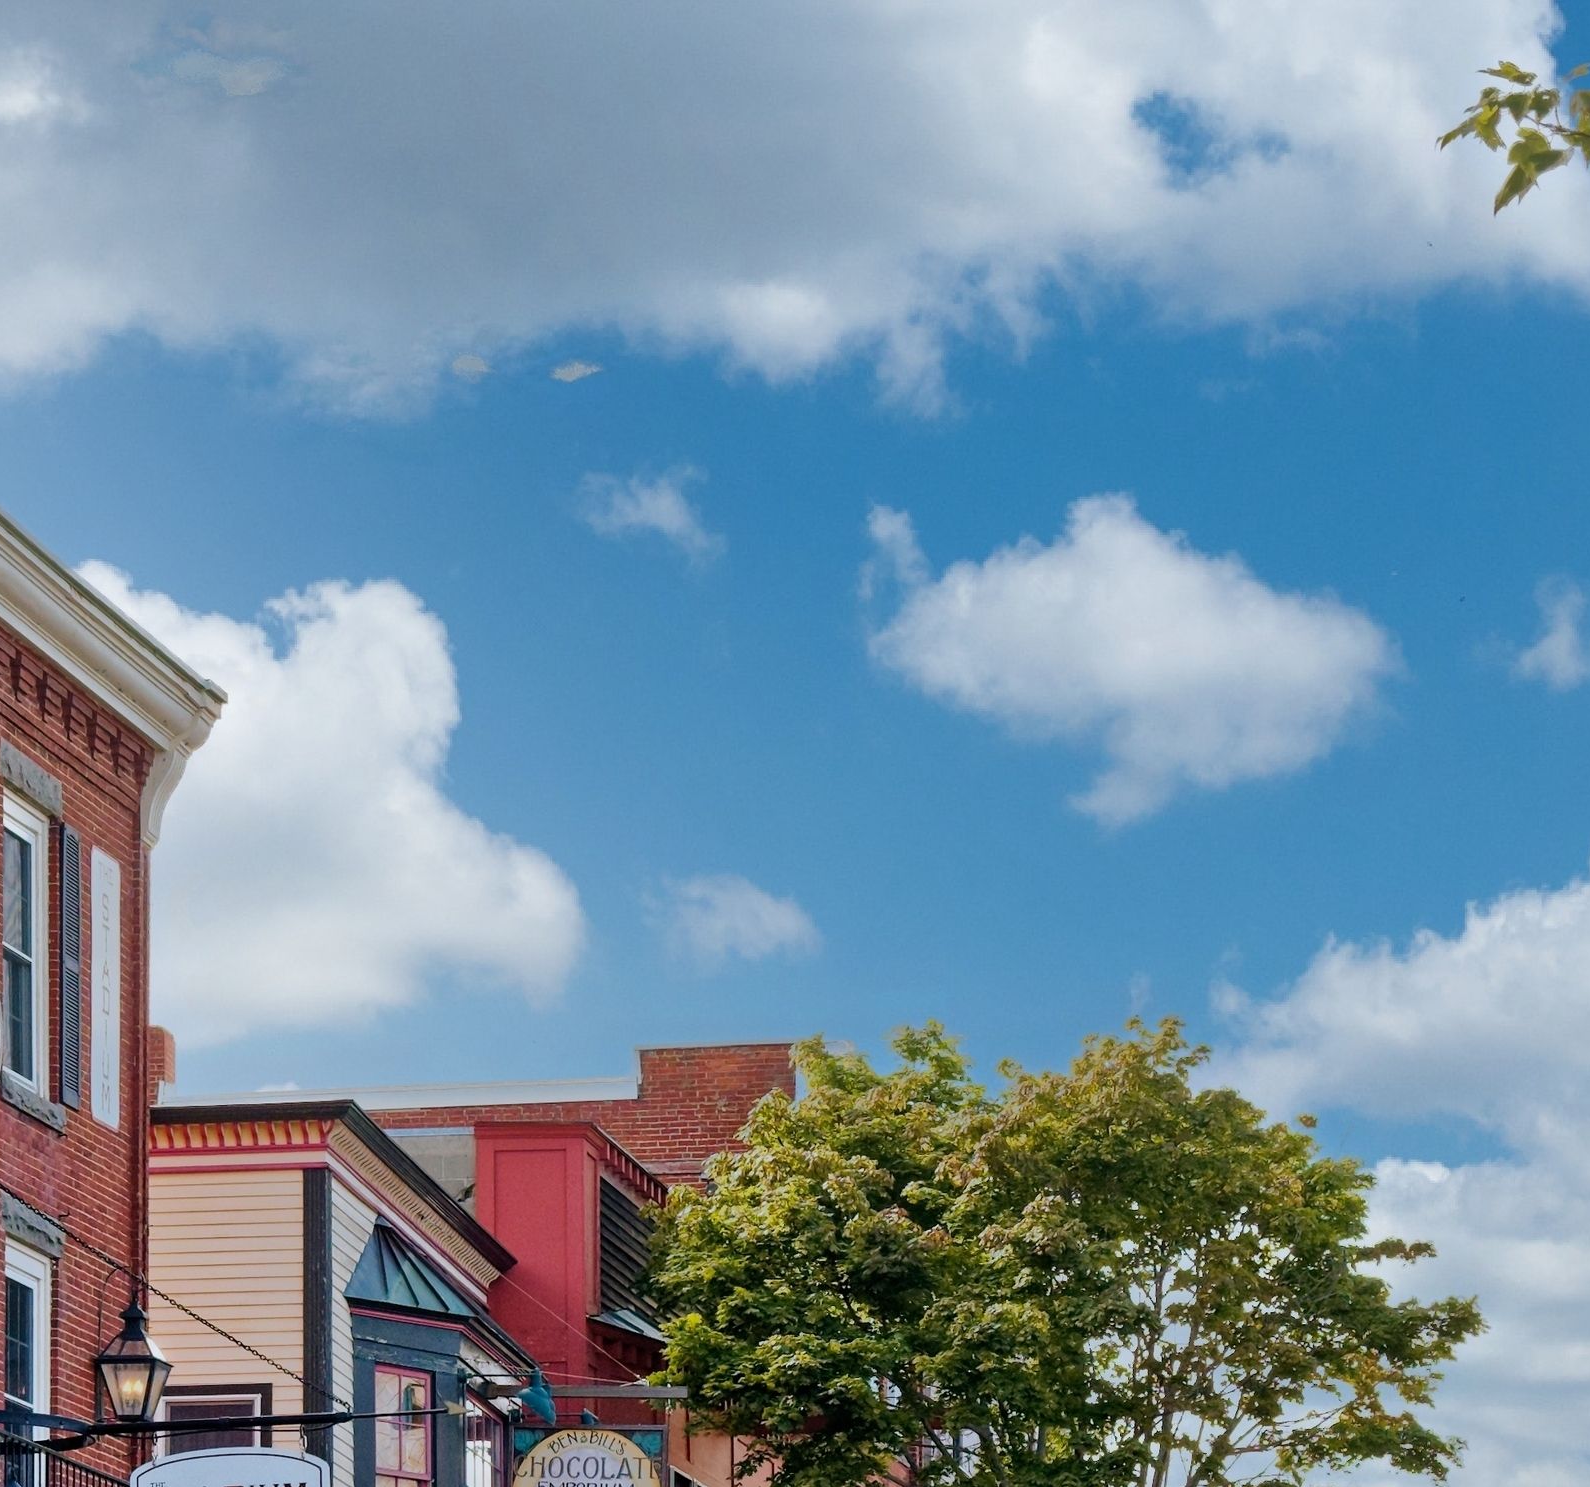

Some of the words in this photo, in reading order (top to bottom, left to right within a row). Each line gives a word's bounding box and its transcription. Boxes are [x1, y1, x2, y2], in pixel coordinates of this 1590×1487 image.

[101, 893, 111, 1116] STADIUM
[547, 1431, 577, 1455] BEN
[589, 1431, 625, 1456] BILL'S
